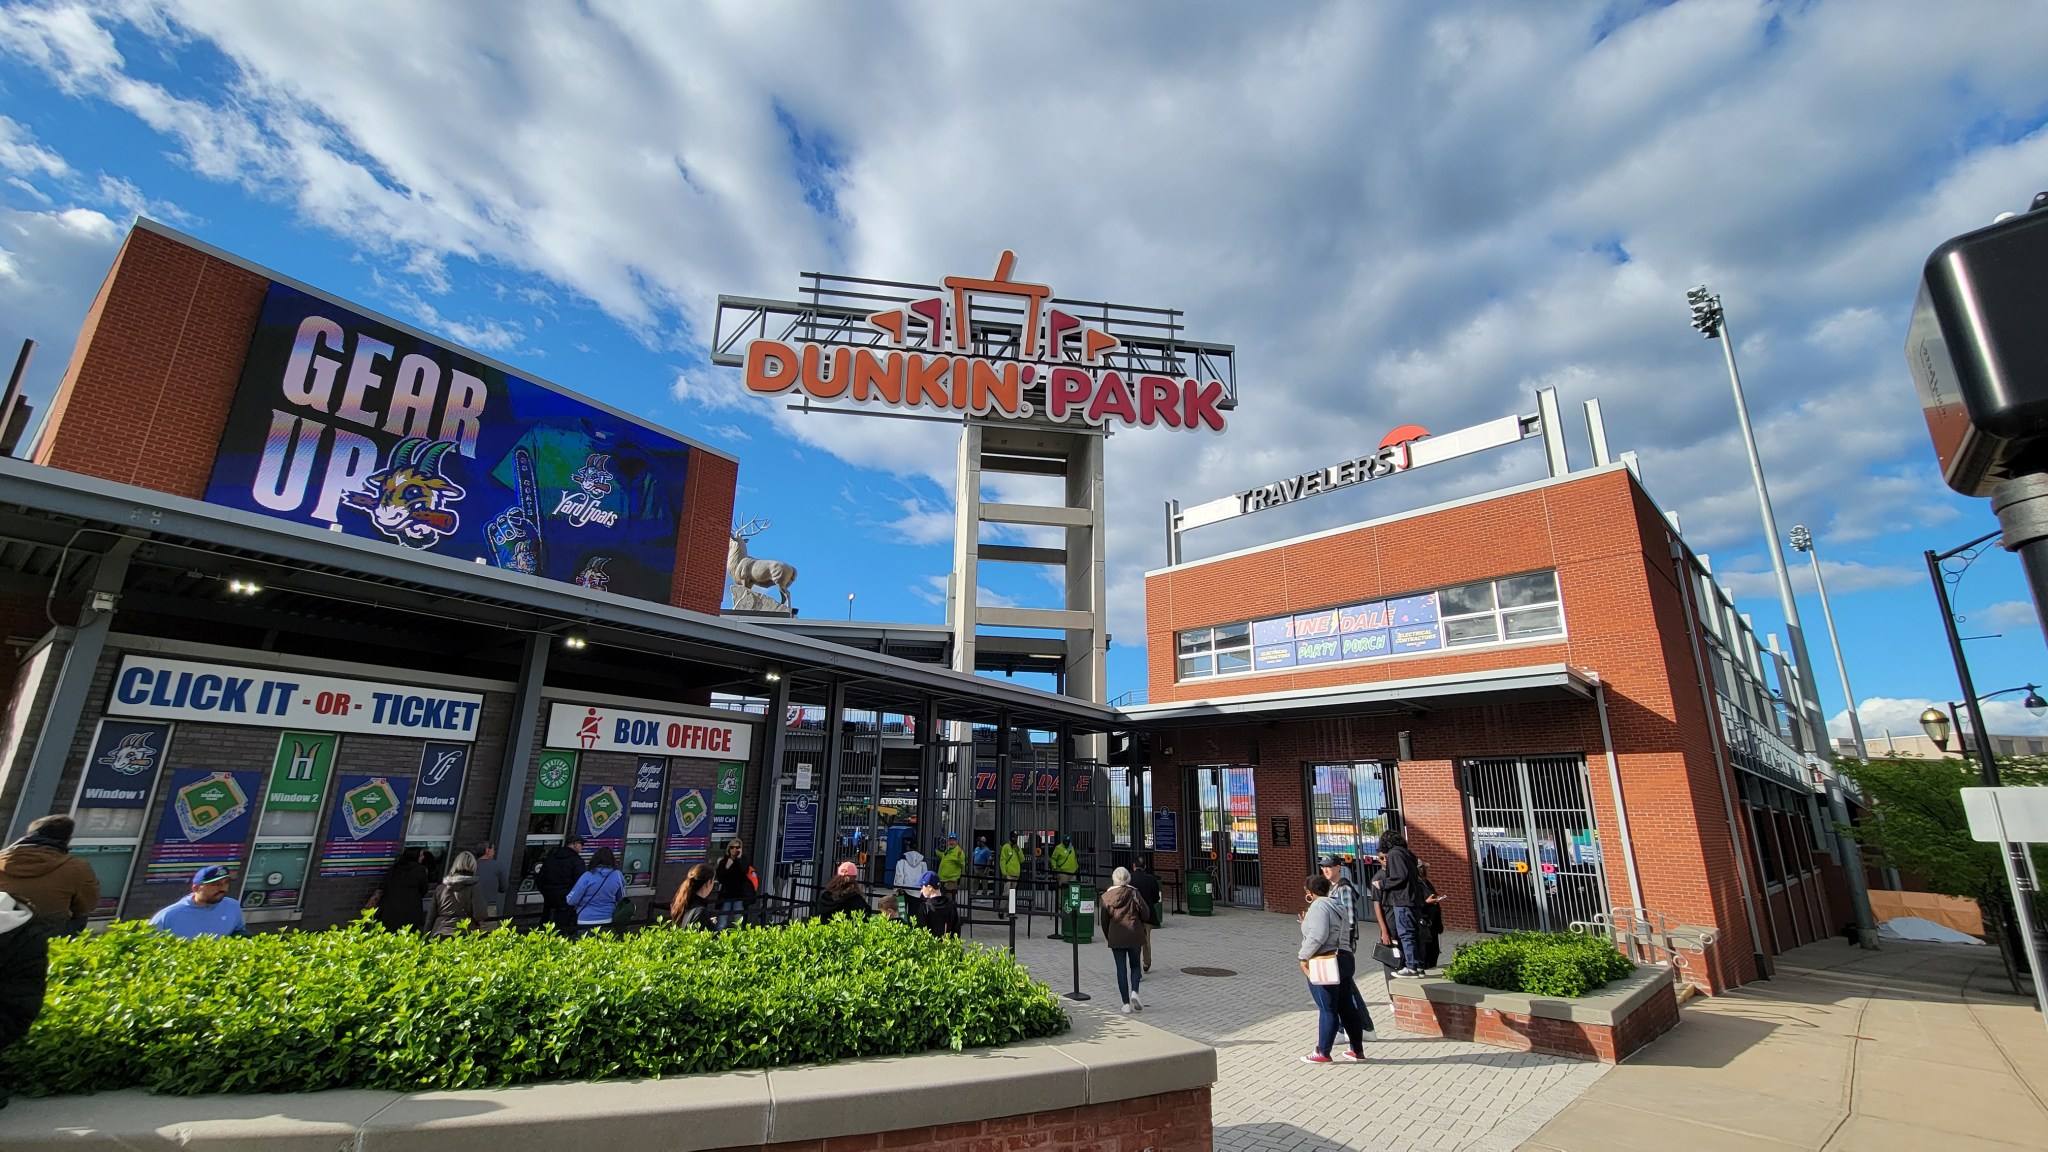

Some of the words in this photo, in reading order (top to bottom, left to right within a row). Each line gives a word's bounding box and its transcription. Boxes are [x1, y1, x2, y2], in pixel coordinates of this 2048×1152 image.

[282, 315, 488, 459] GEAR
[745, 339, 1037, 417] DUNKIN'
[1048, 364, 1227, 434] PARK
[253, 409, 378, 523] UP
[1237, 449, 1393, 514] TRAVELERS
[552, 490, 588, 517] Yard
[571, 499, 618, 527] Goats
[1341, 607, 1397, 635] DALE
[1298, 641, 1337, 660] PARTY
[1343, 635, 1386, 655] PORCH
[117, 666, 254, 713] CLICK
[256, 681, 299, 716] IT
[372, 693, 480, 732] TICKET
[613, 718, 660, 746] BOX
[666, 723, 732, 752] OFFICE
[85, 788, 137, 800] Window
[138, 789, 145, 800] 1
[270, 792, 308, 803] Window
[309, 793, 318, 803] 2
[416, 796, 447, 806] Window
[447, 797, 455, 806] 3
[534, 799, 561, 807] Window
